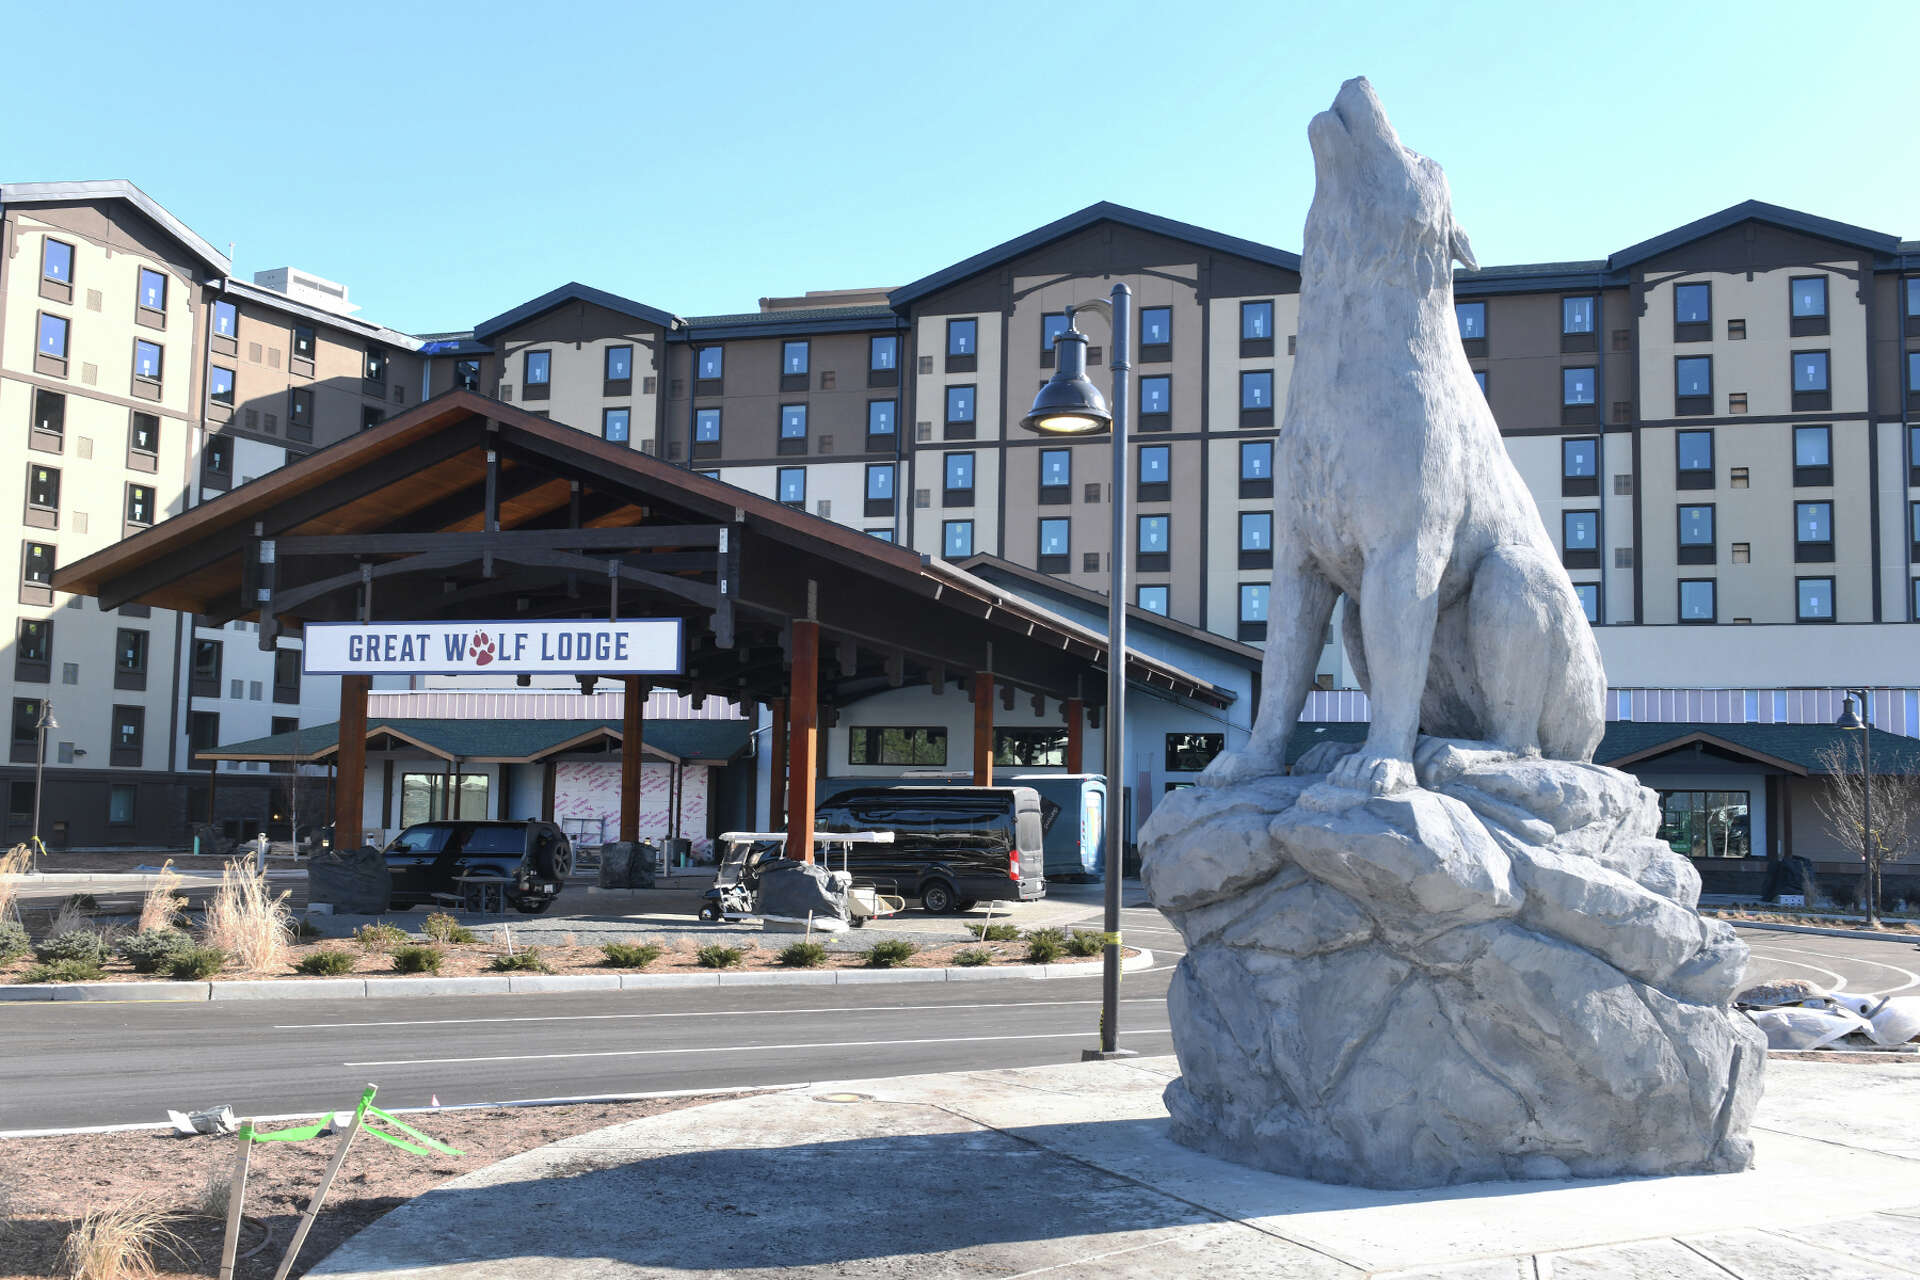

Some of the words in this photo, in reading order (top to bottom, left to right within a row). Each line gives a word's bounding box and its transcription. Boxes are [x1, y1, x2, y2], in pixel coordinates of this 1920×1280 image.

[348, 633, 431, 662] GREAT
[444, 629, 529, 666] WLF
[541, 631, 629, 661] LODGE
